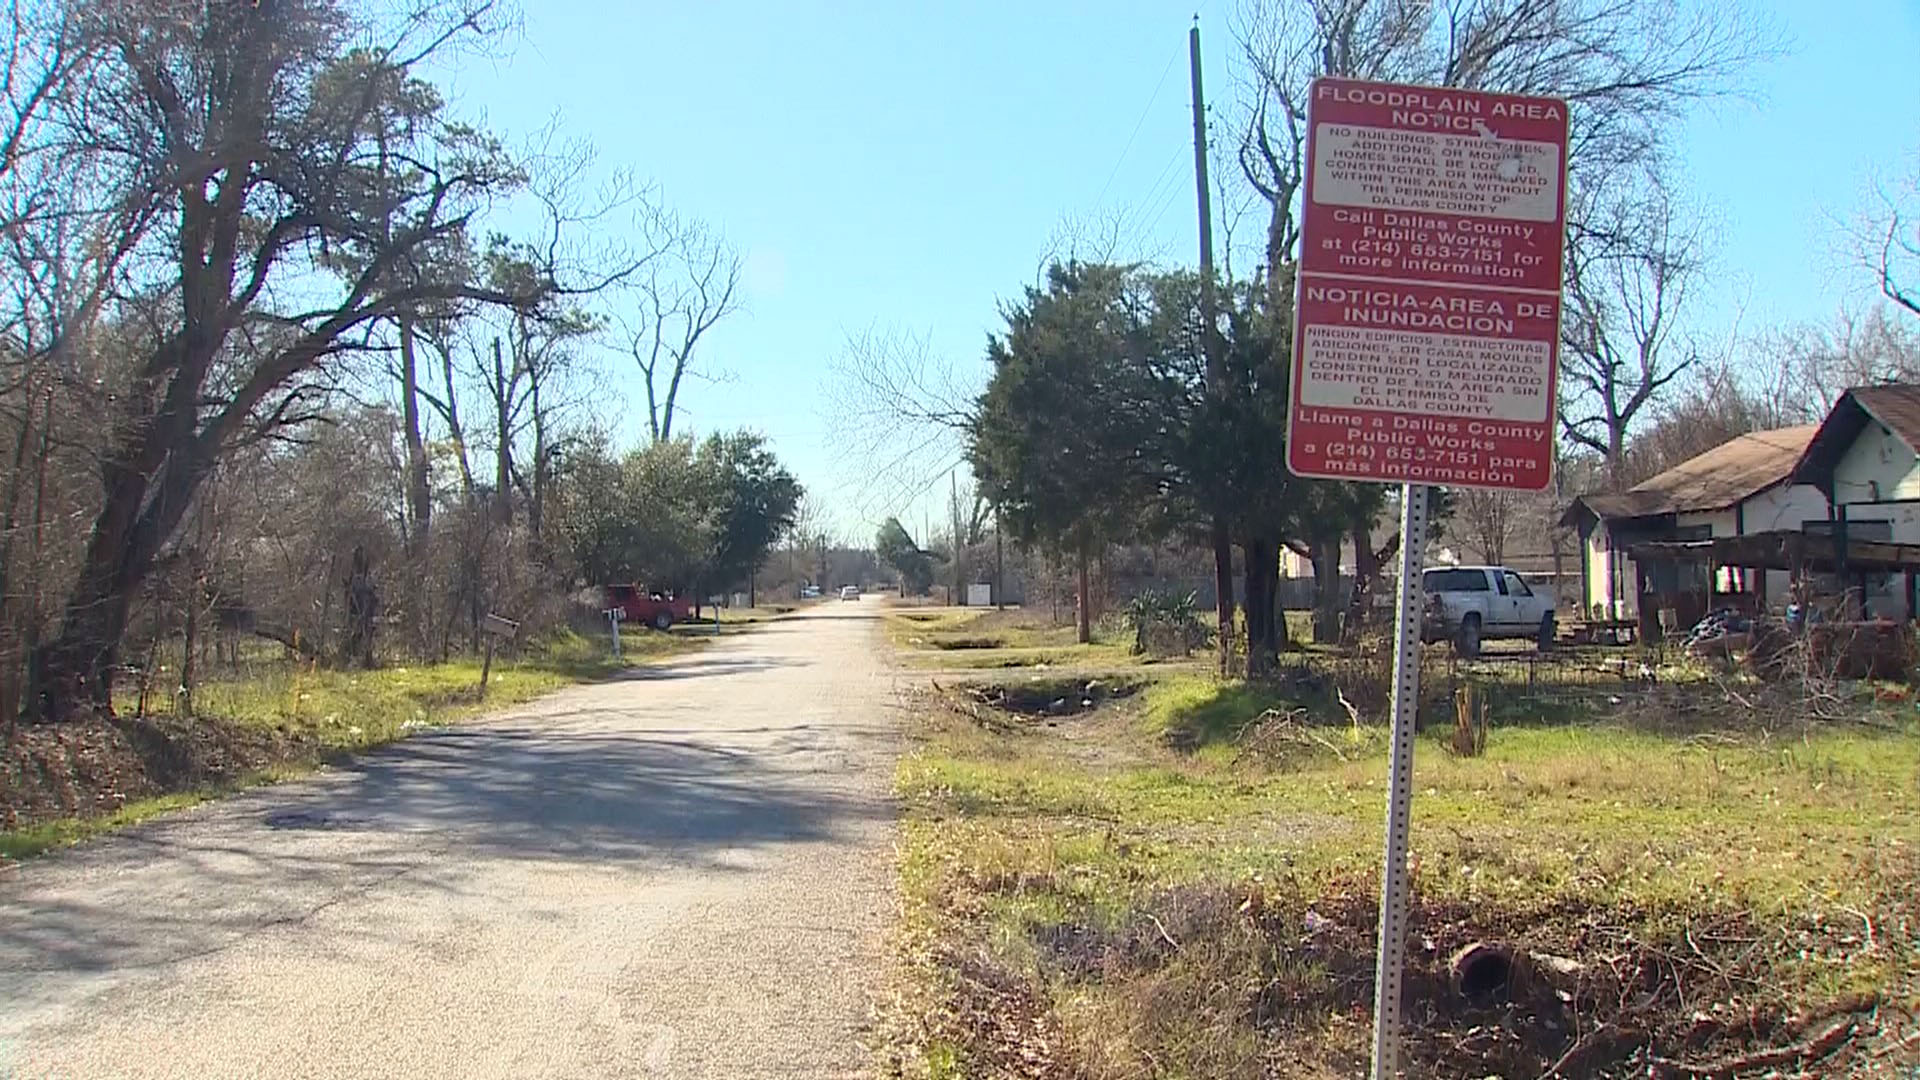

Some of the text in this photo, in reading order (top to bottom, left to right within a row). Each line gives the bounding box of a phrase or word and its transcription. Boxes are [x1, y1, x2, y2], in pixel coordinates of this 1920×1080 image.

[1318, 86, 1560, 120] FLOODPLAIN AREA
[1392, 111, 1487, 130] NOTICE
[1329, 128, 1351, 137] NO
[1333, 151, 1540, 175] HOMES SHALL BE LOCED,
[1442, 148, 1462, 157] OR
[1332, 171, 1541, 195] WITHIN THIS AREA WITHOUT
[1445, 169, 1466, 179] OR
[1361, 184, 1511, 203] THE PERMISSION OF
[1372, 196, 1497, 213] DALLAS COUNTY
[1334, 210, 1533, 239] Call Dallas County
[1364, 226, 1502, 248] Public Works
[1322, 238, 1543, 265] at (214) 653-7151 for
[1339, 254, 1524, 278] more information
[1307, 287, 1553, 319] NOTICIA-AREA DE
[1344, 308, 1514, 333] INUNDACION
[1308, 328, 1360, 340] NINGUN
[1315, 351, 1382, 363] PUEDEN
[1388, 355, 1419, 366] SER
[1401, 346, 1420, 356] OR
[1427, 348, 1474, 359] CASAS
[1480, 352, 1543, 364] MOVILES
[1312, 372, 1539, 396] DENTRO DE ESTA AREA SIN
[1430, 370, 1441, 378] O
[1448, 370, 1543, 385] MEJORADO
[1353, 396, 1494, 415] DALLAS COUNTY
[1361, 387, 1489, 403] EL PERMISO DE
[1299, 410, 1544, 440] Llame a Dallas County
[1347, 428, 1495, 451] Public Works
[1304, 443, 1536, 470] a (214) 653-7151 para
[1325, 457, 1515, 483] más información
